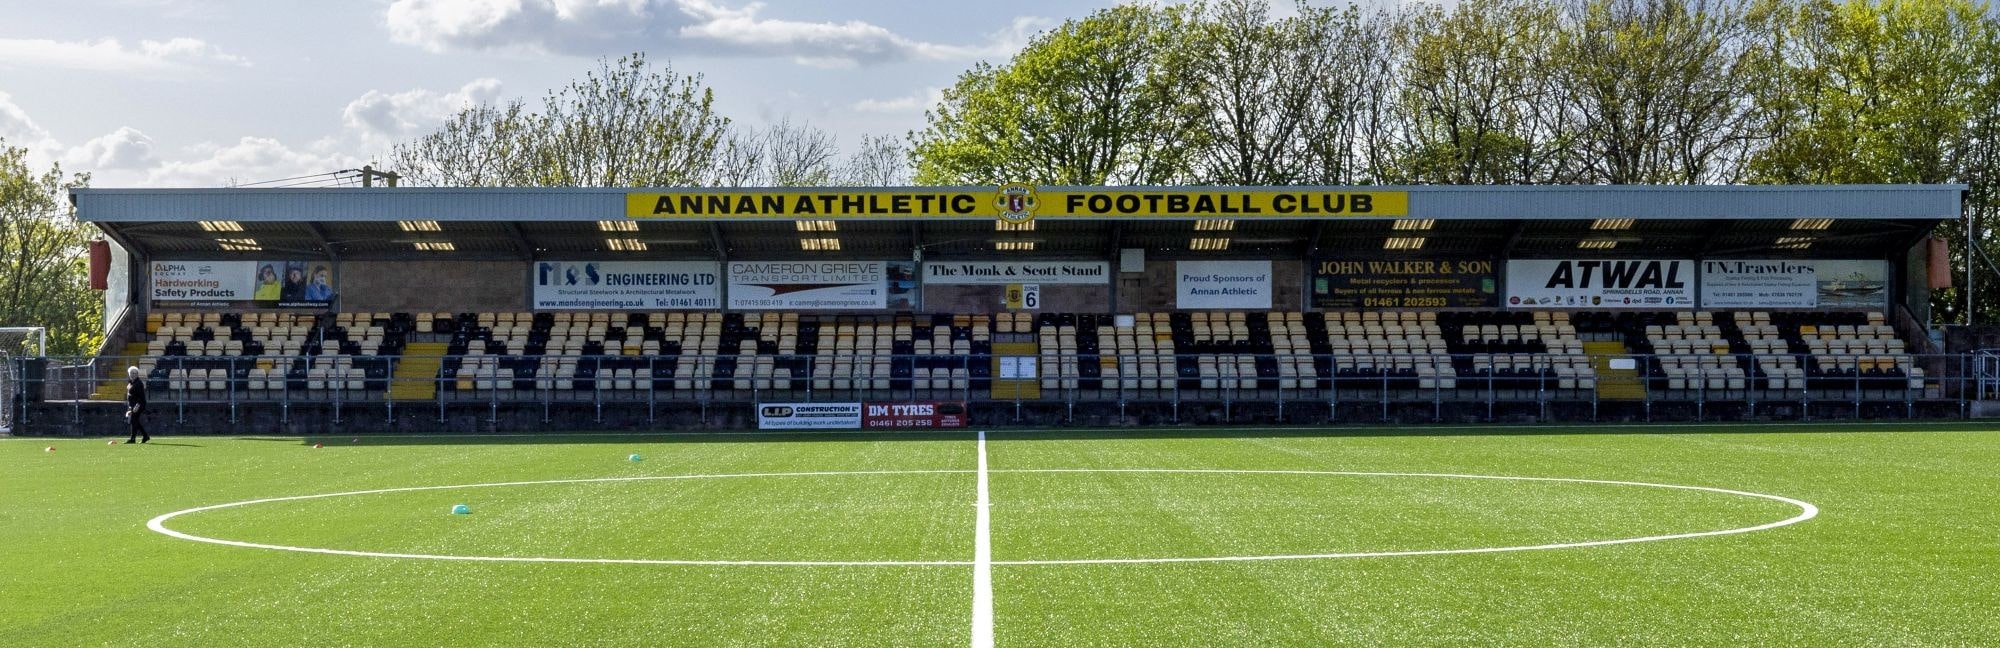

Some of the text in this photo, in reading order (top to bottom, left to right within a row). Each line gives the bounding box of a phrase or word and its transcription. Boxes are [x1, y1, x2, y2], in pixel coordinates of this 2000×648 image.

[652, 194, 976, 214] ANNAN ATHLETIC
[1066, 194, 1373, 214] FOOTBALL CLUB
[155, 263, 186, 272] ALPHA
[732, 263, 878, 274] CAMERON GRIEVE
[930, 264, 1102, 276] The Monk & Scott Stand
[1318, 261, 1492, 275] JOHN WALKER & SON
[1704, 261, 1815, 274] TN.Trawlers
[606, 273, 715, 286] ENGINEERING LTD
[732, 274, 879, 282] TRANSPORT LIMITED
[1183, 274, 1266, 284] Proud Sponsors of
[1545, 261, 1685, 288] ATWAL
[155, 279, 219, 289] Hardworking
[1372, 278, 1408, 286] recyclers
[1418, 278, 1460, 286] processors
[155, 289, 235, 298] Safety Products
[1190, 287, 1258, 295] Annan Athletic
[539, 298, 644, 308] www.mandsengineering.co.uk
[655, 298, 669, 307] Tel:
[670, 299, 692, 307] 01461
[1026, 292, 1037, 308] 6
[1364, 297, 1399, 307] 01461
[1403, 297, 1447, 307] 202593
[868, 404, 933, 416] DM TYRES
